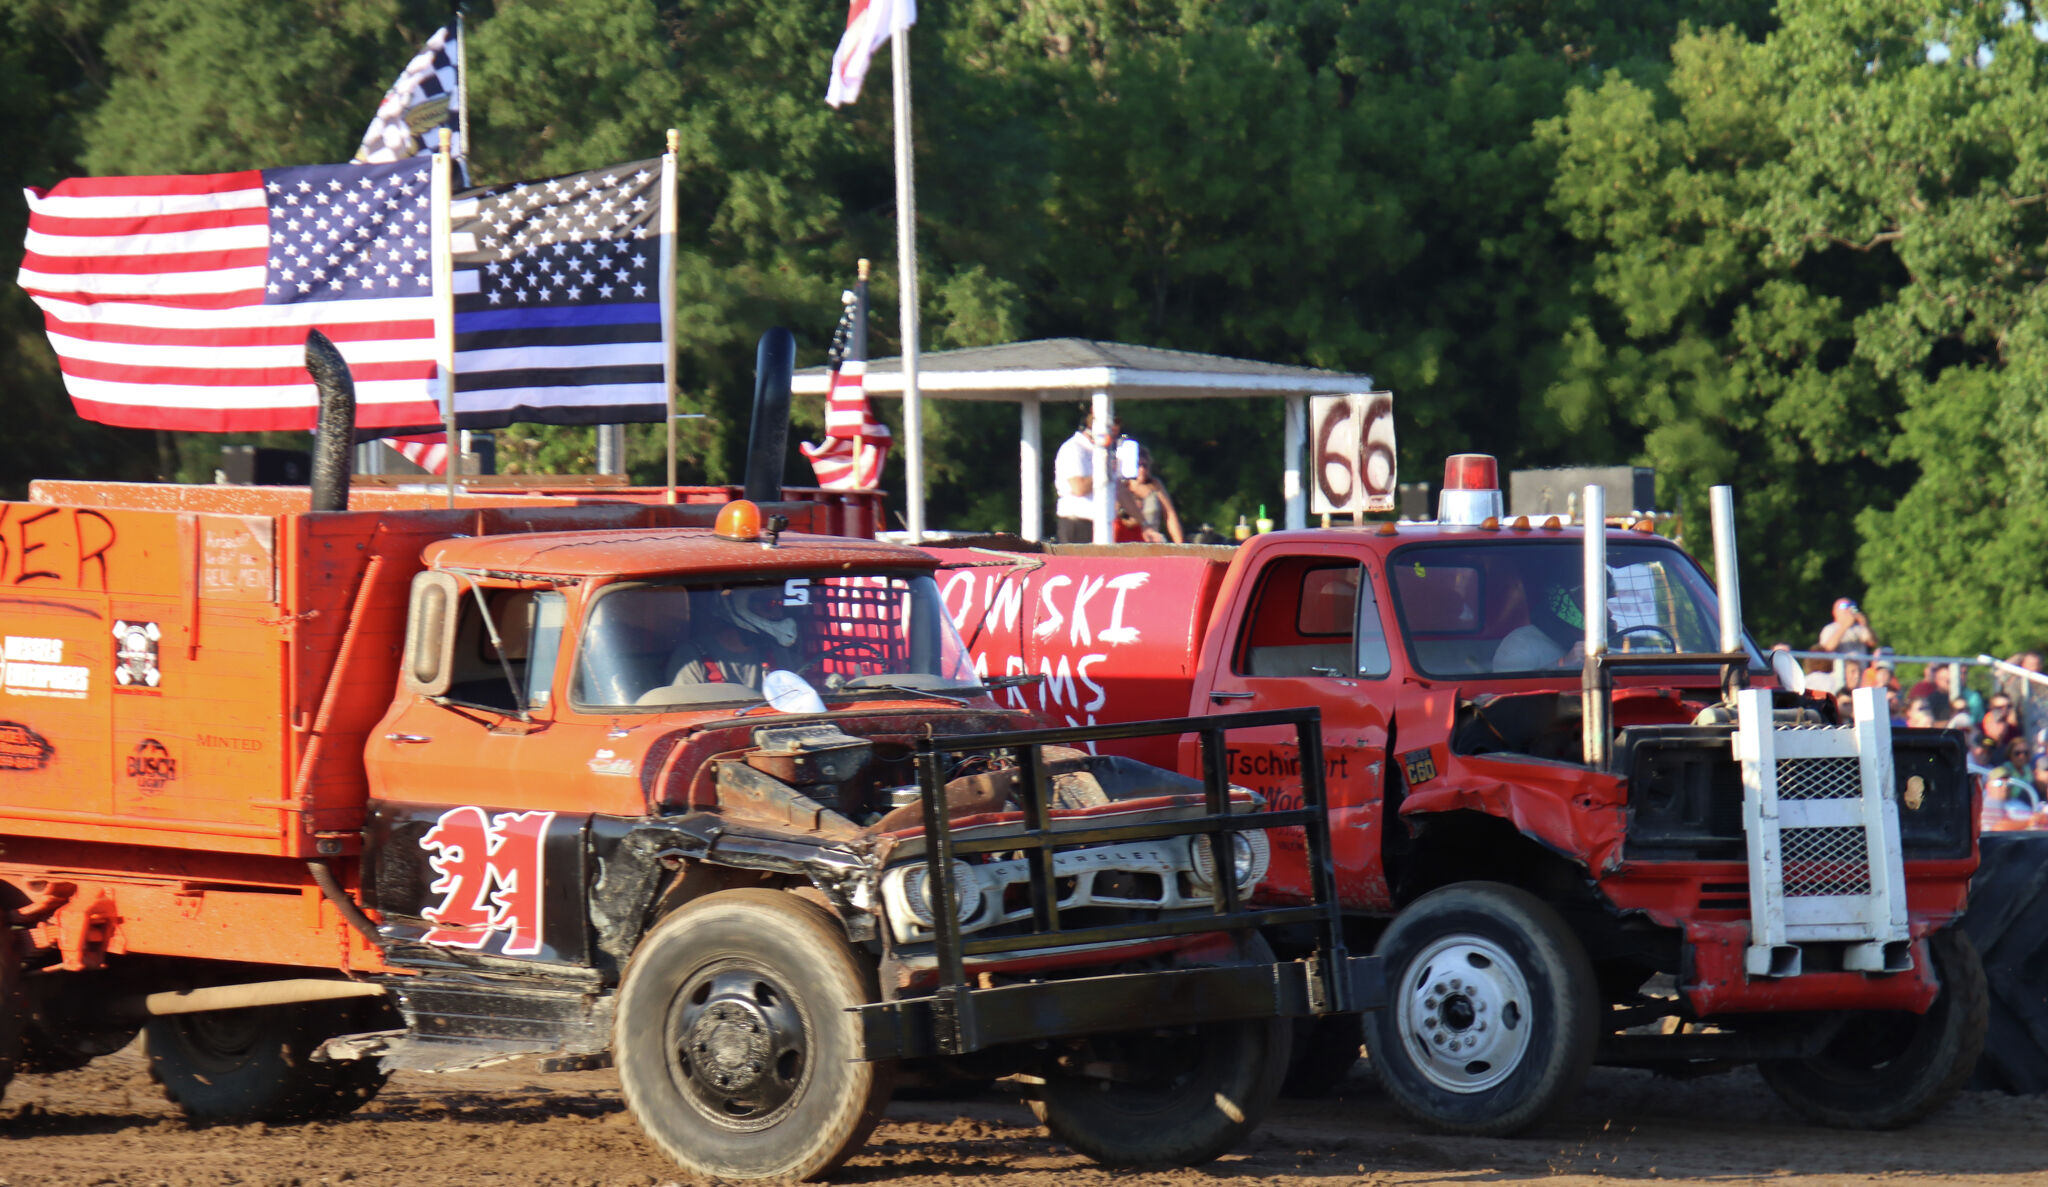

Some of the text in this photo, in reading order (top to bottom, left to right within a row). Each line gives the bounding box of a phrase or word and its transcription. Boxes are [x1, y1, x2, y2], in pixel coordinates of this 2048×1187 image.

[1317, 398, 1395, 509] 66
[0, 503, 116, 594] ER
[872, 569, 1150, 647] OWSKI
[973, 651, 1107, 713] ARMS
[126, 755, 176, 781] BUSCH
[1407, 758, 1436, 785] C60
